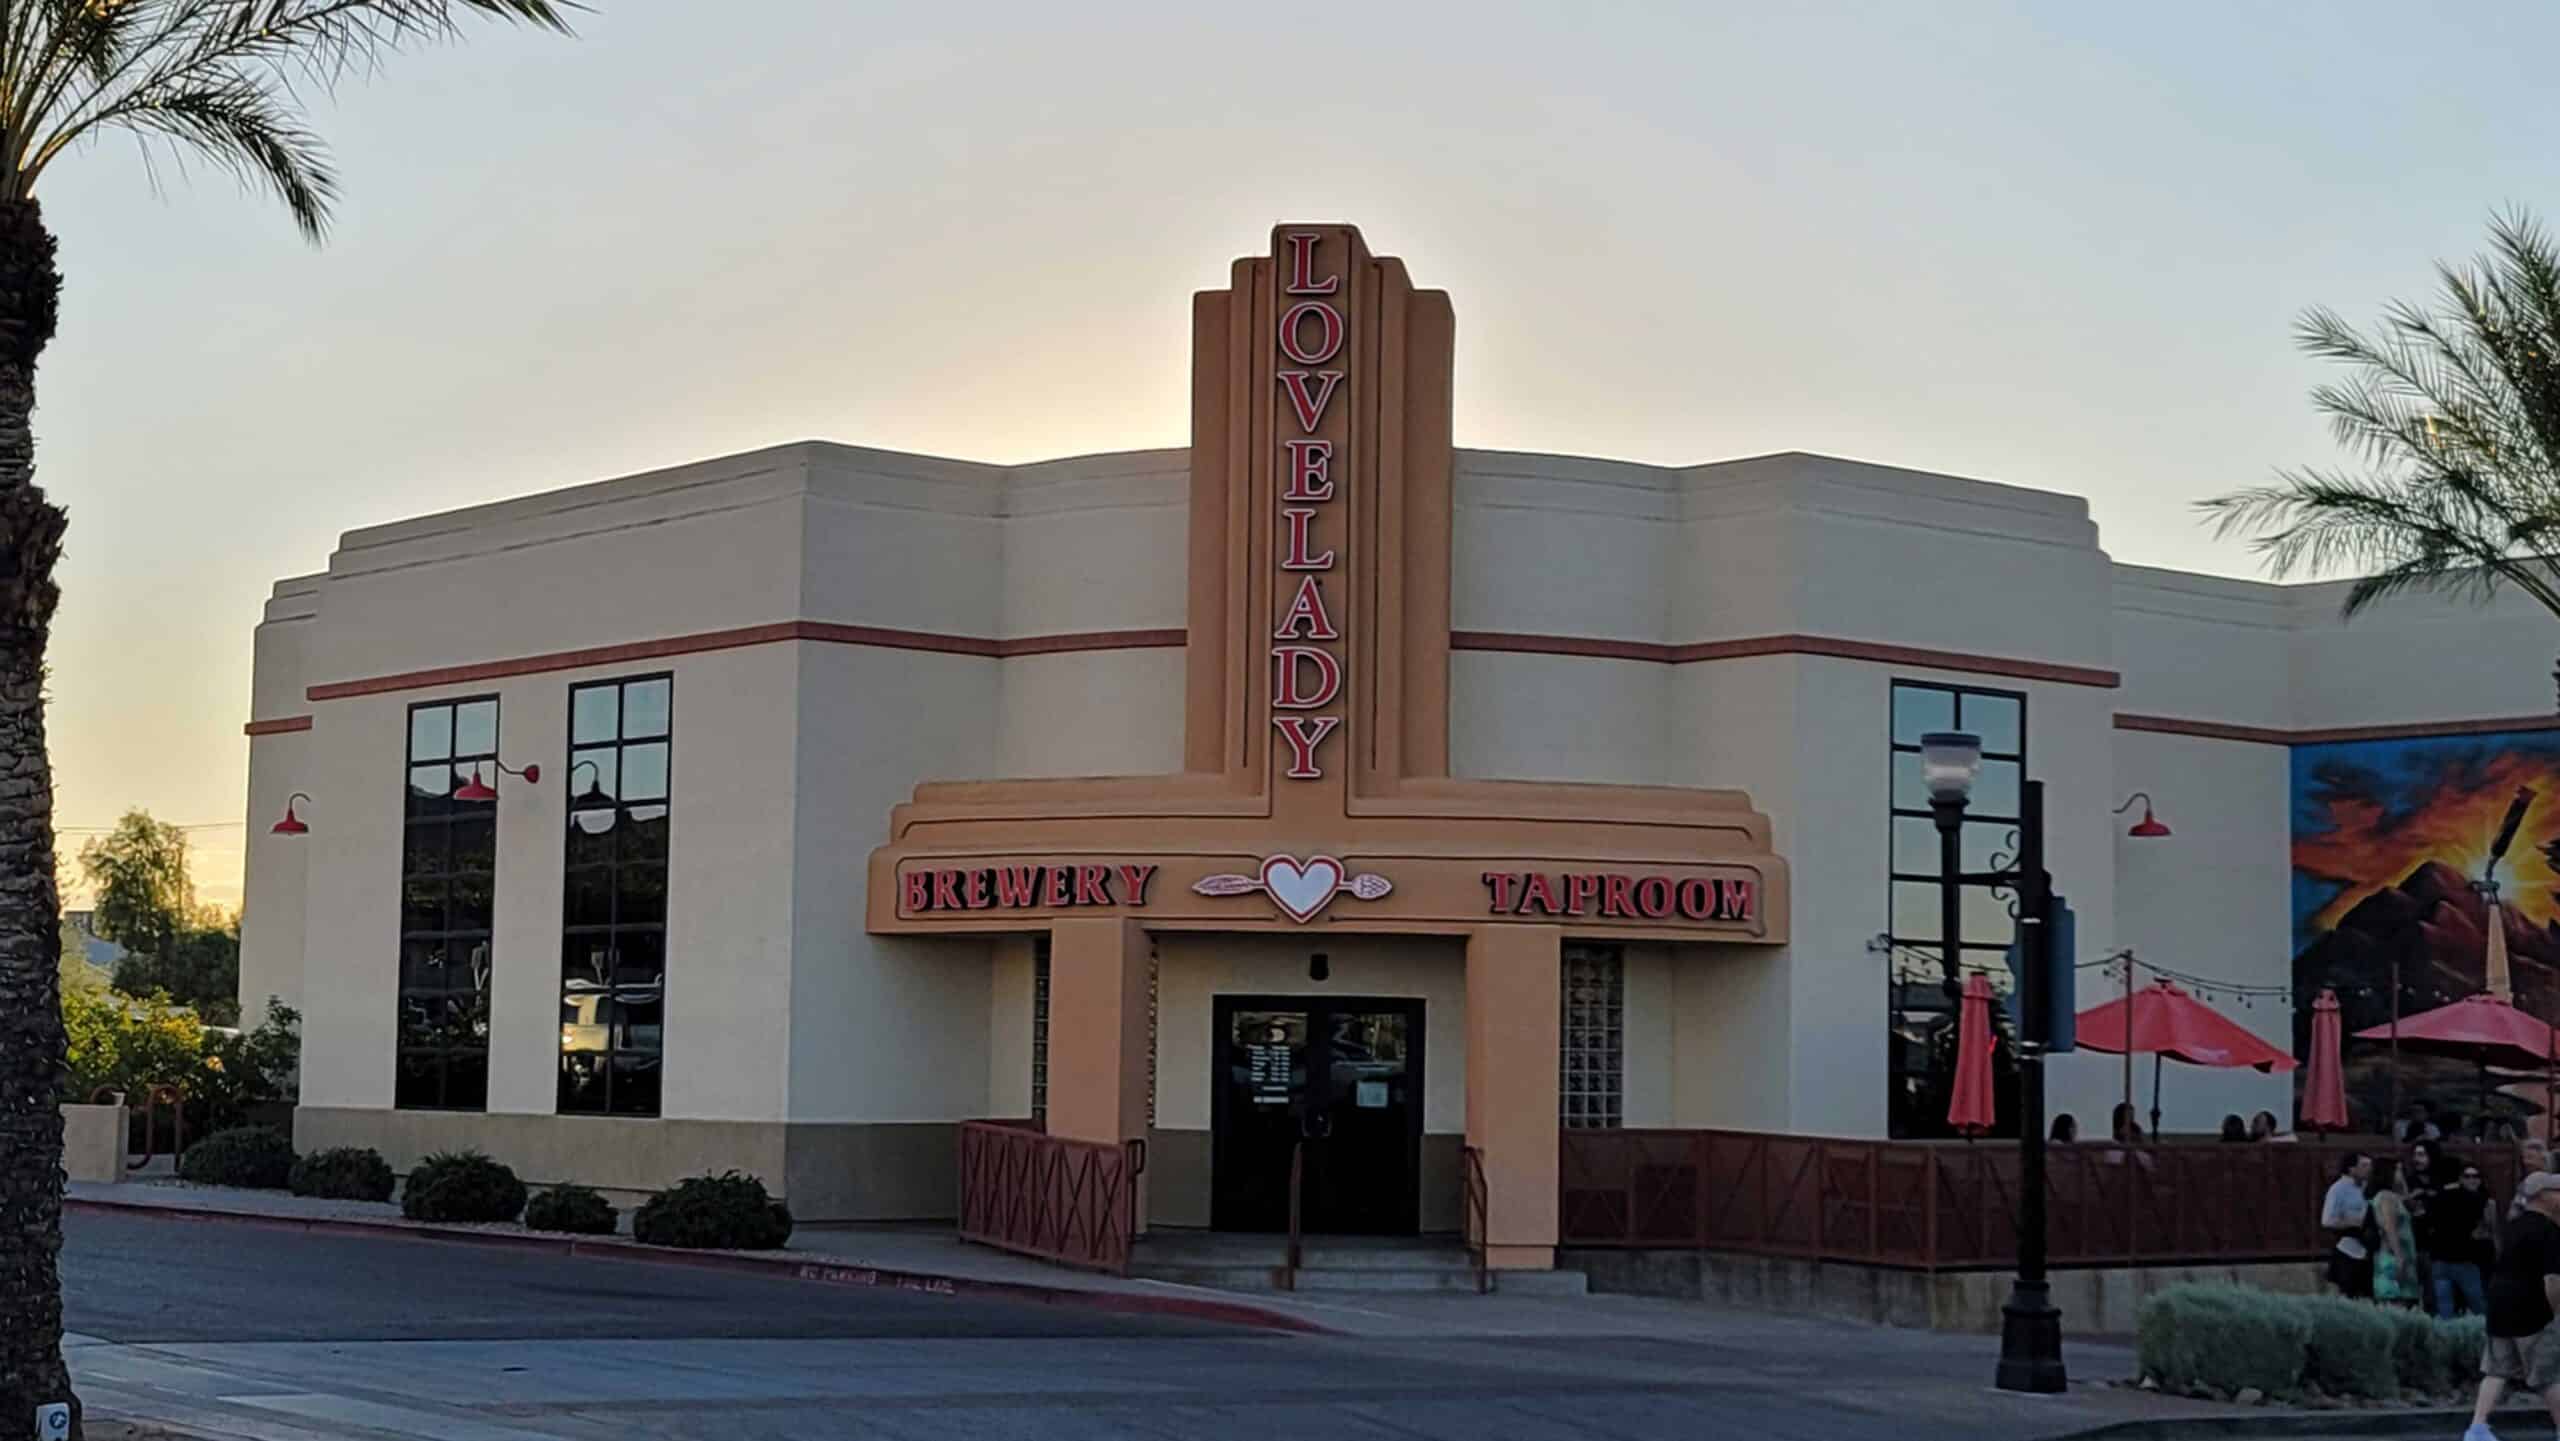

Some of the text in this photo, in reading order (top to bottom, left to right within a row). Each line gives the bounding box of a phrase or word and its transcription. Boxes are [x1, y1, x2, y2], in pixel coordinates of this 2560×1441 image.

[1272, 233, 1344, 779] LOVELADY
[904, 865, 1158, 912] BREWERY
[1482, 872, 1755, 920] TAPROOM
